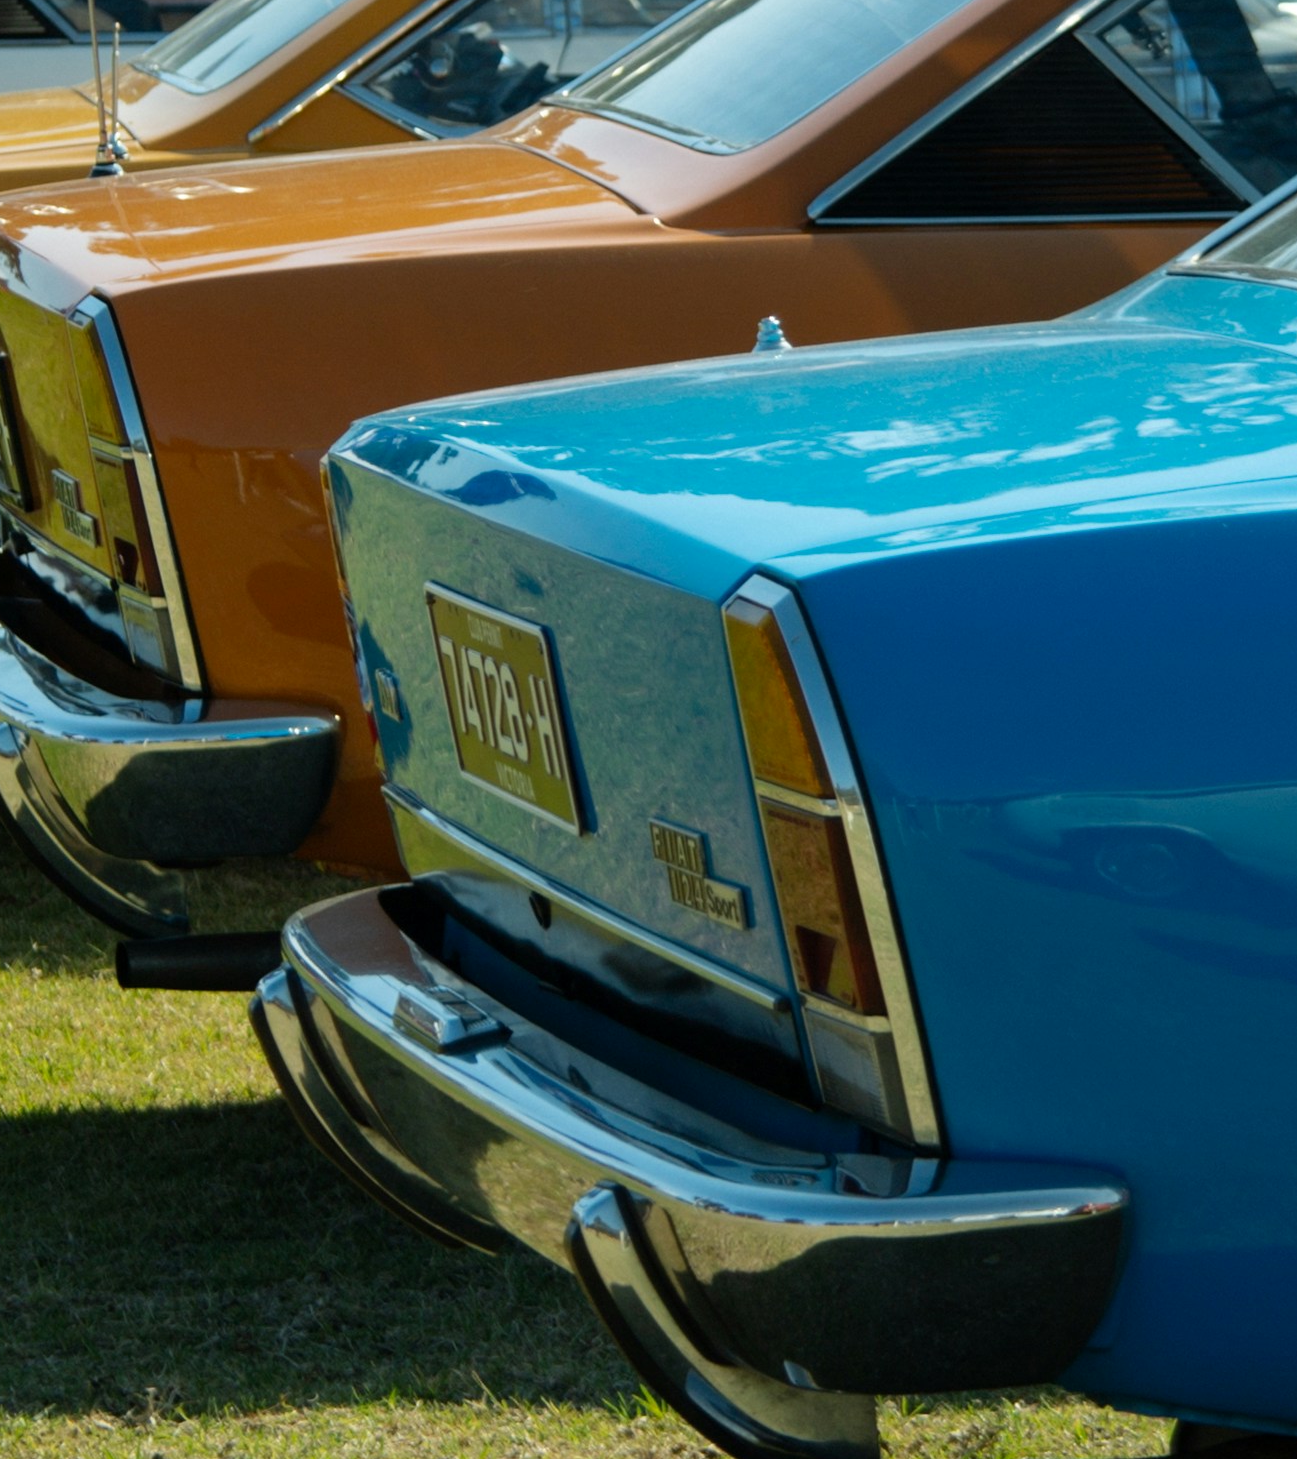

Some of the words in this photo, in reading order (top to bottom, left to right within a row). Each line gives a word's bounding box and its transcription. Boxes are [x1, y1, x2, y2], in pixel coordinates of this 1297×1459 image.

[494, 759, 536, 802] VICTORIA
[652, 825, 697, 872] FIAT
[706, 885, 741, 922] Sport
